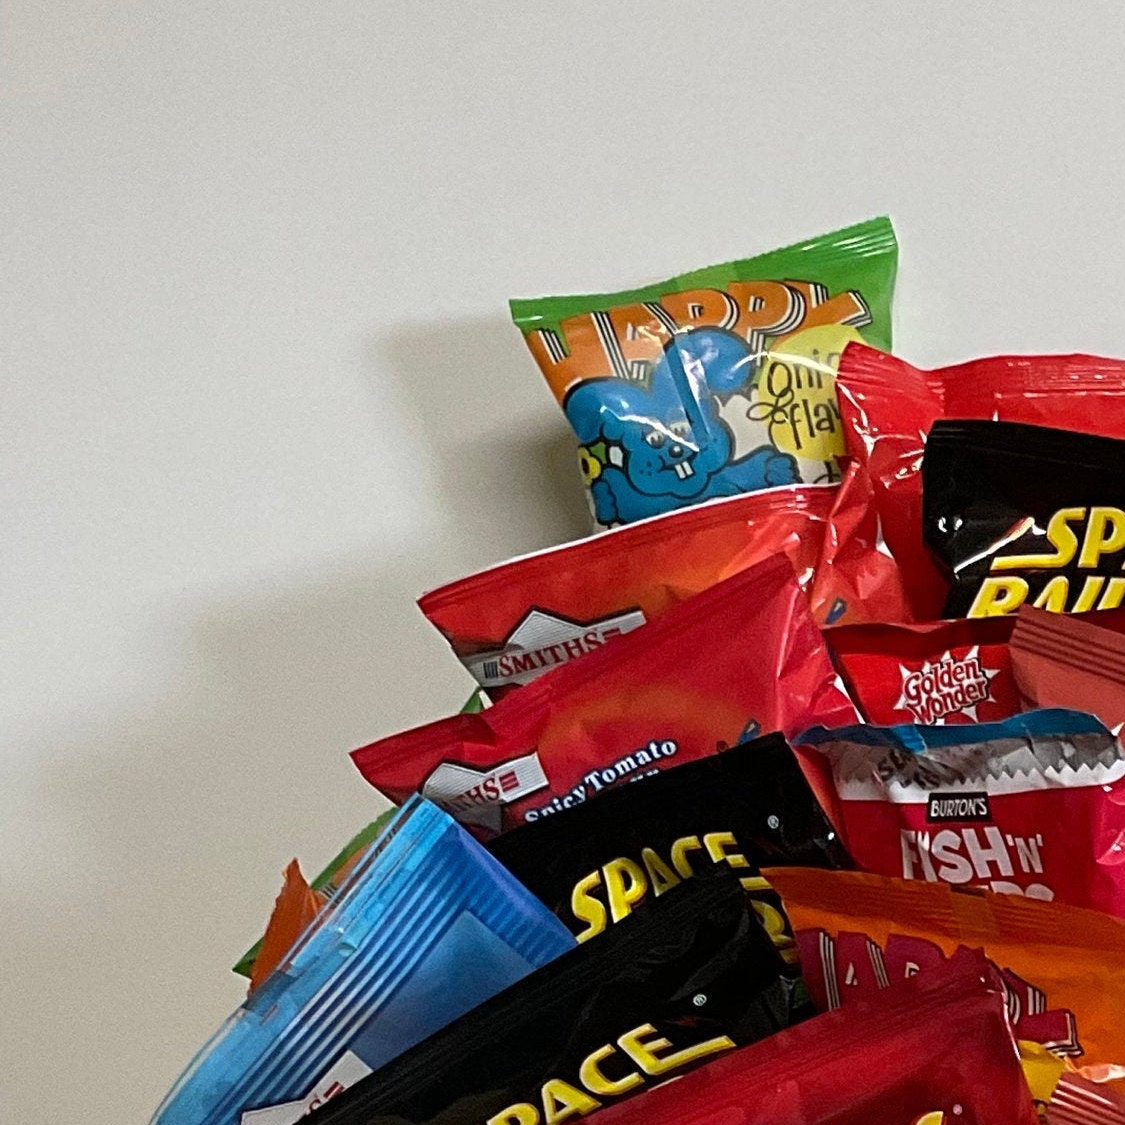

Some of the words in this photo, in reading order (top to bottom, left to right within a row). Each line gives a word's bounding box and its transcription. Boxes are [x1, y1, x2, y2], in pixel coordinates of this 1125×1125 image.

[498, 630, 602, 678] SMITHS
[904, 661, 979, 704] Golden
[906, 680, 987, 724] Wonder
[584, 740, 678, 793] Tomato
[930, 797, 988, 818] BURTON'S
